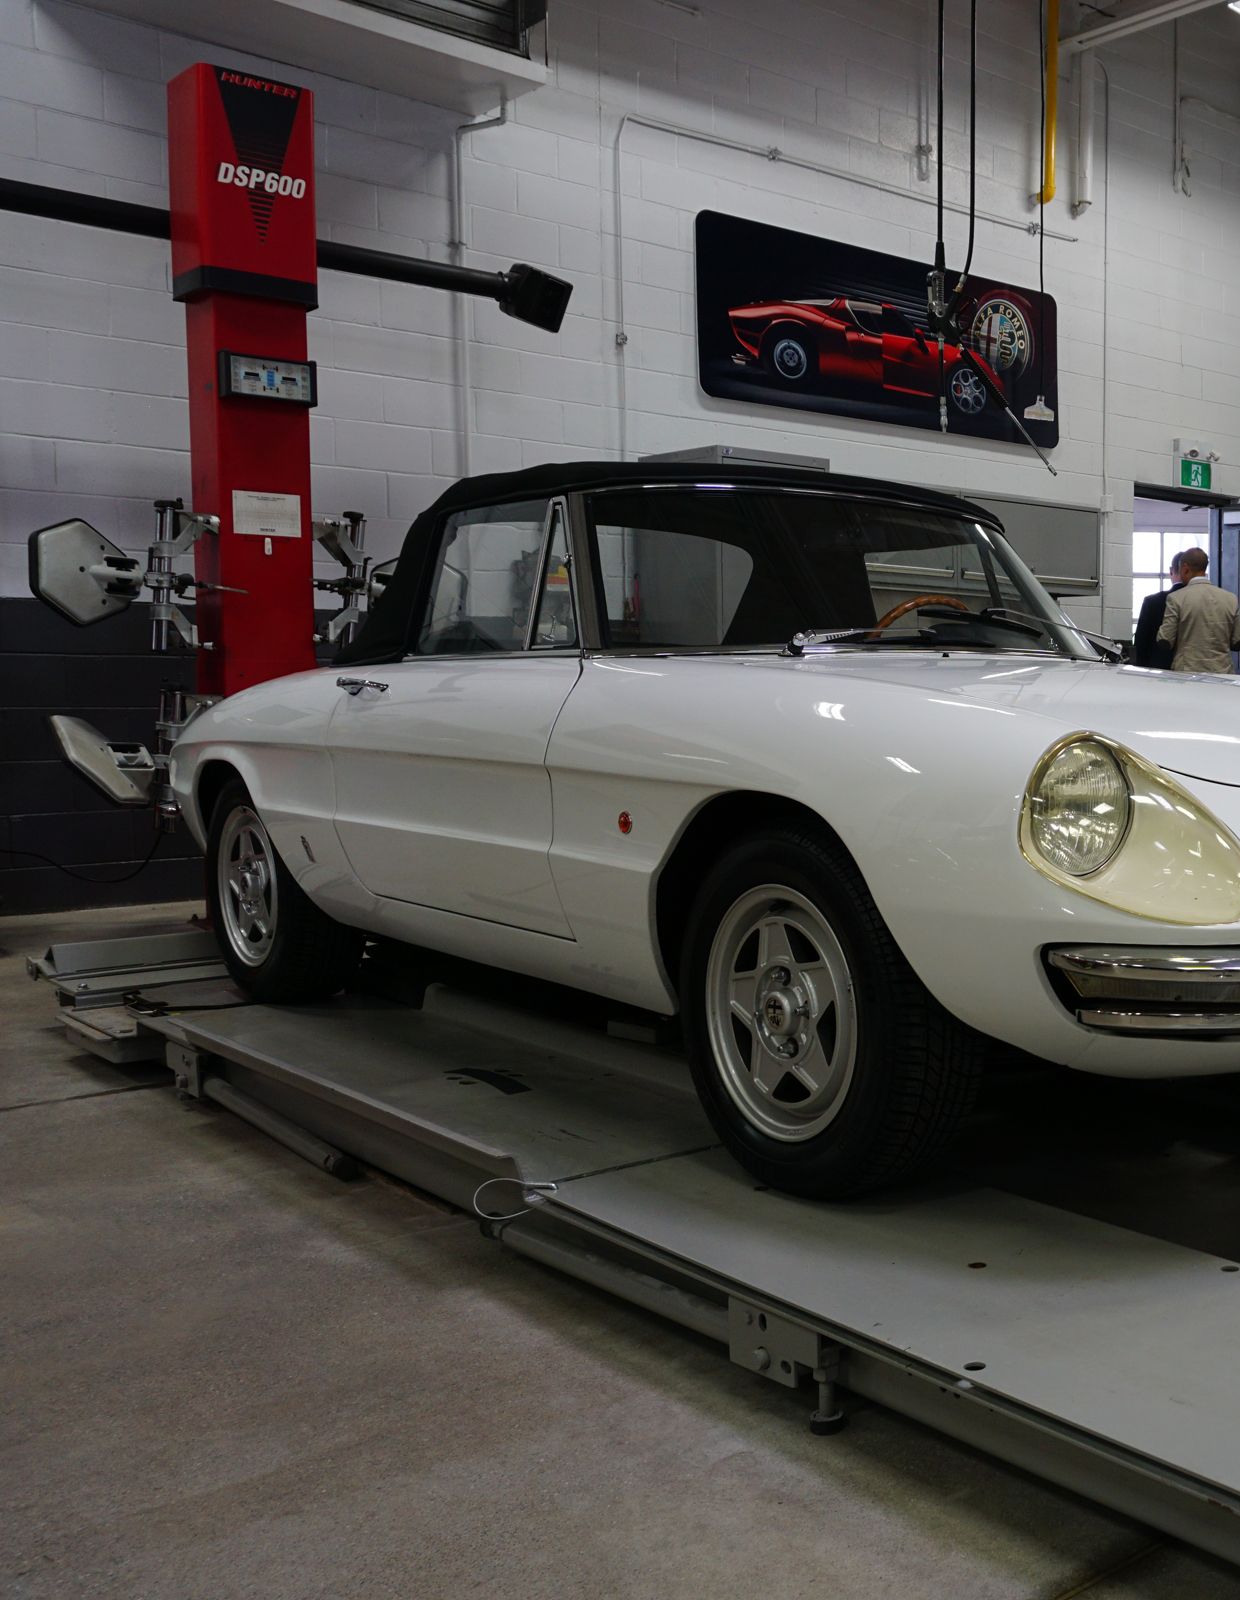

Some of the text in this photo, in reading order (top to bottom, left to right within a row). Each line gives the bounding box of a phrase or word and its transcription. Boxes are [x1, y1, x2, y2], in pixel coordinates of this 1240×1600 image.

[220, 71, 298, 99] HUNTER
[217, 162, 306, 199] DSP600
[999, 304, 1025, 350] ROMEO
